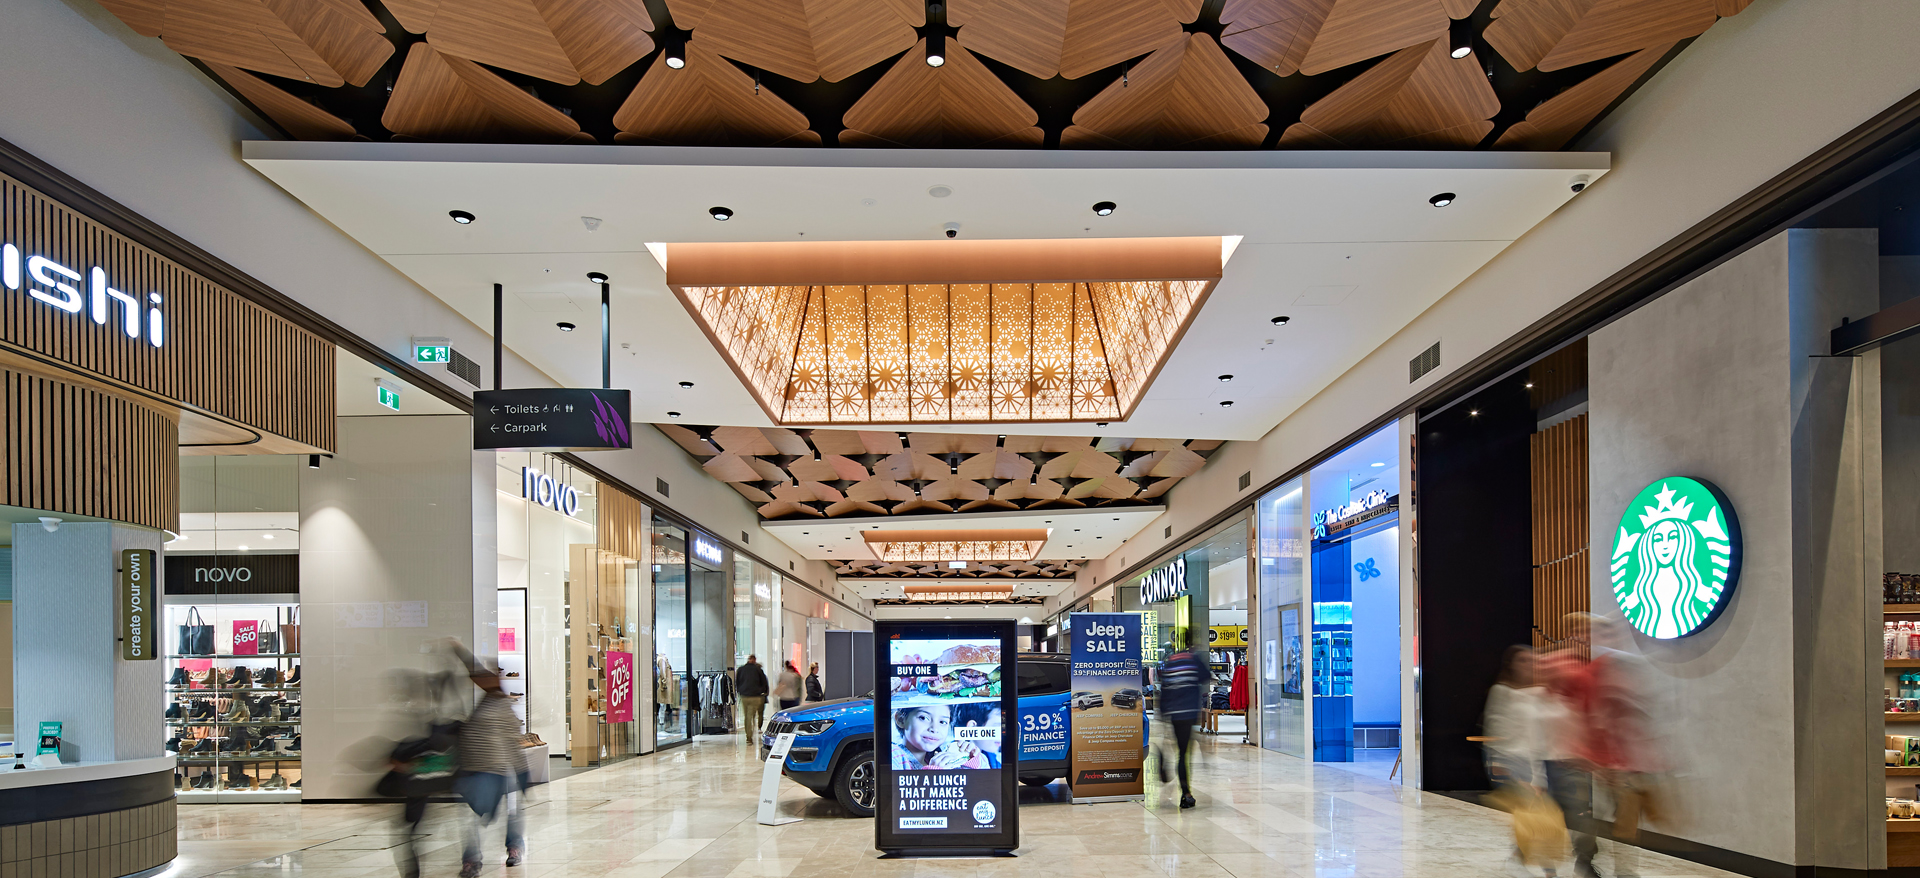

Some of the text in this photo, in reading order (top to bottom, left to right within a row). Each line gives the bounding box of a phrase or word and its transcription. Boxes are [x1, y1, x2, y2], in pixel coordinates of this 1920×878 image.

[504, 404, 540, 414] Toilets
[504, 423, 547, 434] Carpark
[522, 466, 578, 517] novo
[1326, 489, 1388, 525] The Cosmetic Clinic
[195, 567, 252, 582] novo
[1140, 557, 1187, 606] CONNOR
[130, 553, 142, 657] create your own
[239, 625, 254, 634] SALE
[1086, 621, 1125, 639] Jeep
[234, 631, 256, 646] $60
[1086, 640, 1126, 652] SALE
[897, 666, 931, 675] BUY ONE
[1095, 661, 1124, 669] DEPOSIT
[611, 662, 630, 689] 70%
[611, 681, 629, 707] OFF
[960, 729, 996, 738] GIVE ONE
[899, 775, 967, 786] BUY A LUNCH
[899, 787, 964, 798] THAT MAKES
[899, 799, 968, 810] A DIFFERENCE
